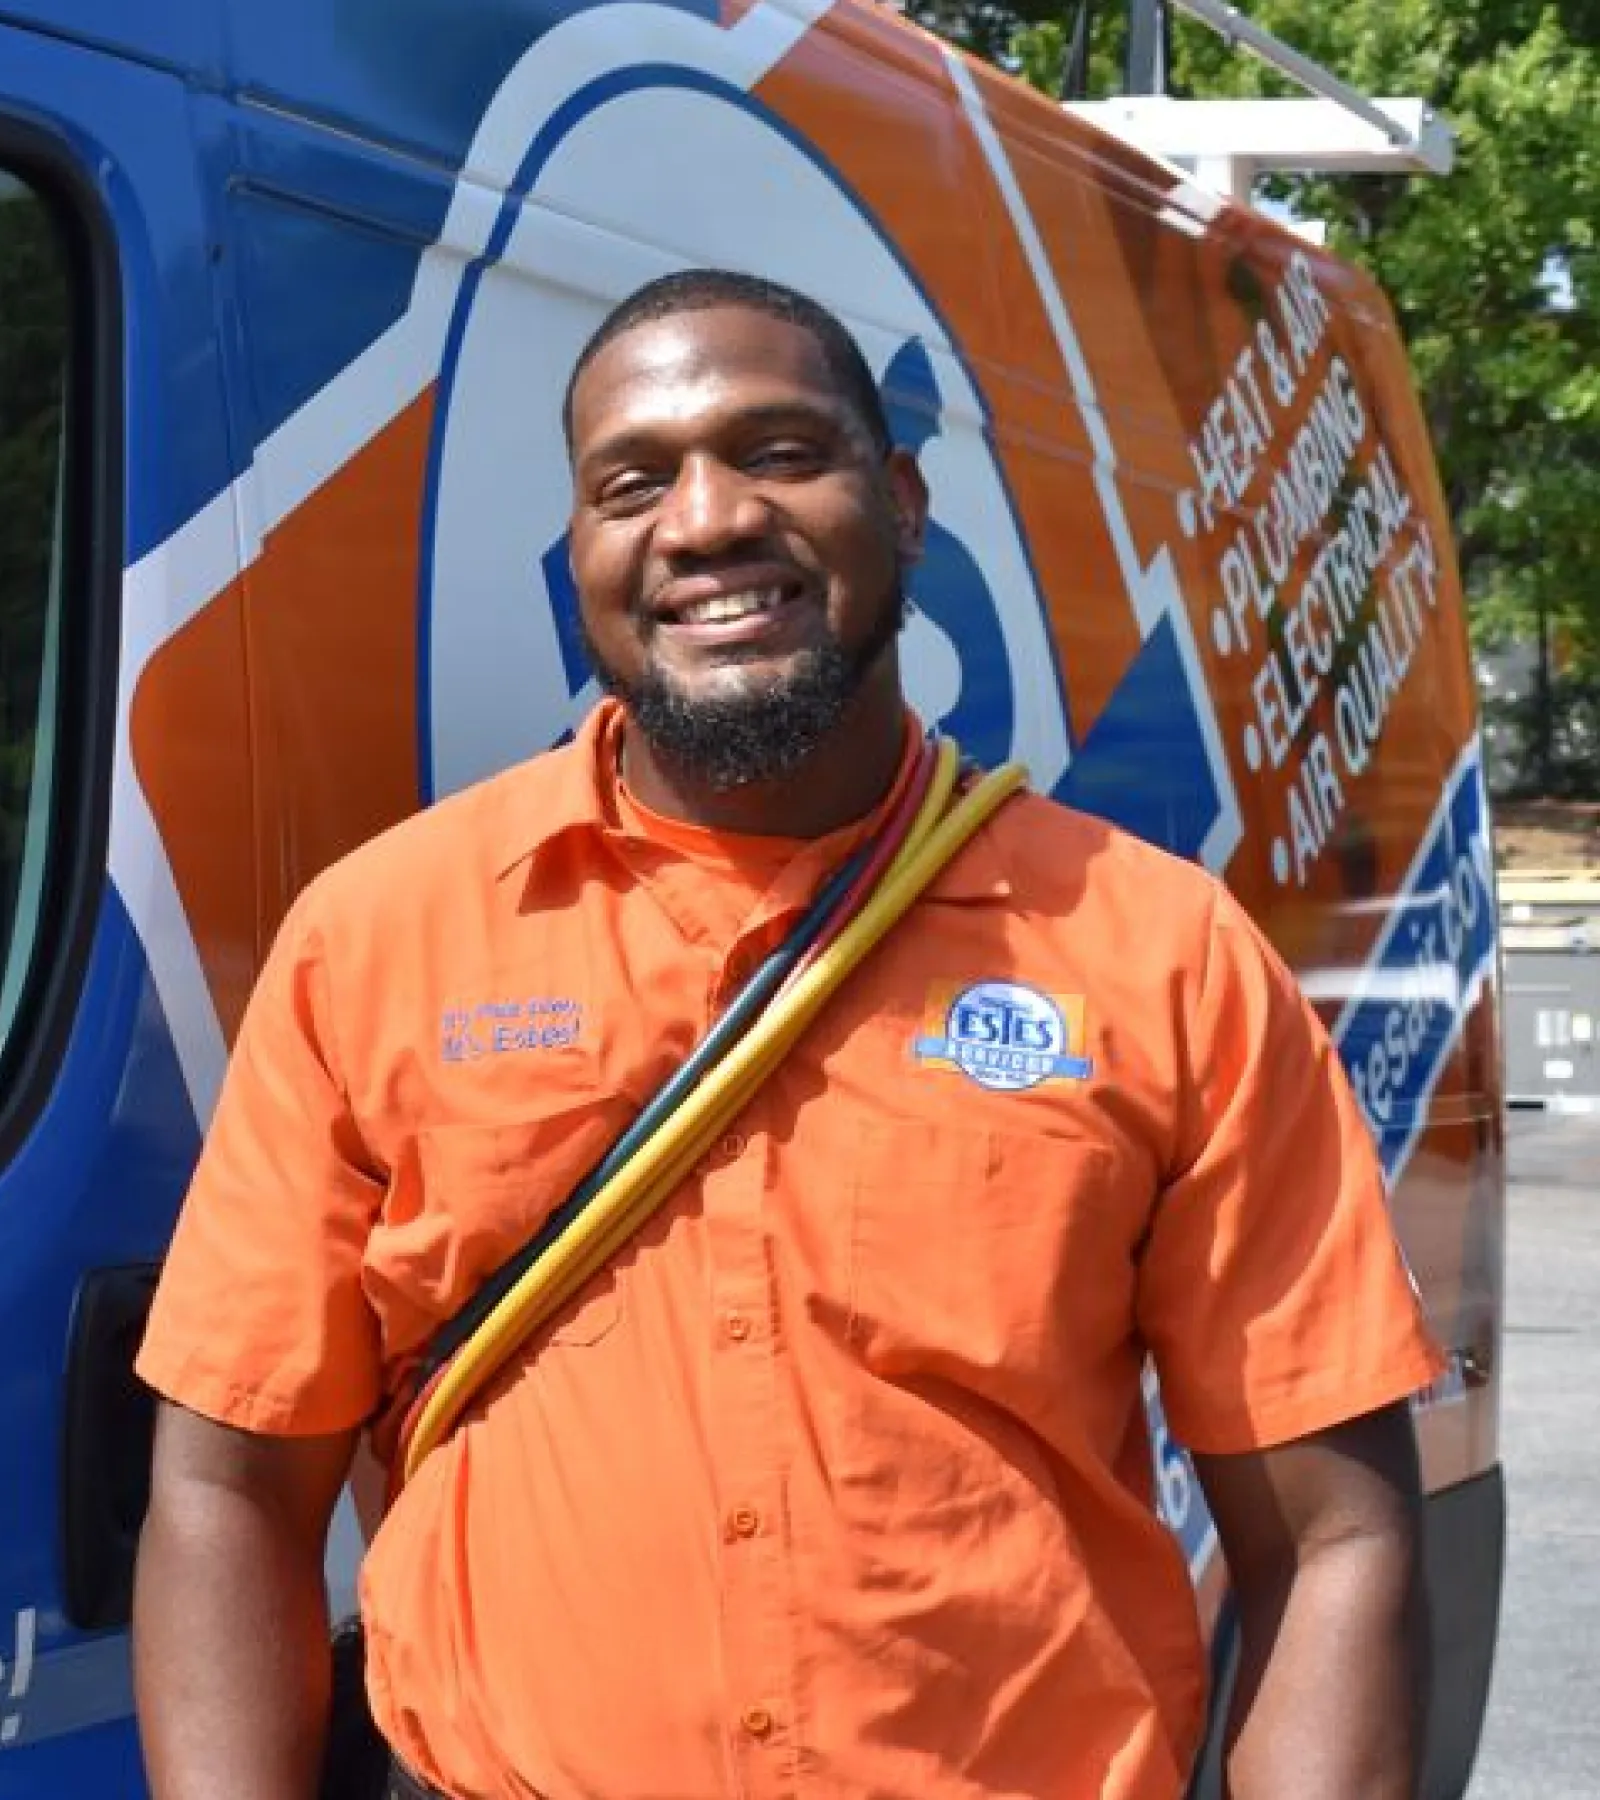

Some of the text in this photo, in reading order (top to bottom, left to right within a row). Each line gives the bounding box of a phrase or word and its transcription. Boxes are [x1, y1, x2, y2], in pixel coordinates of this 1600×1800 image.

[1188, 250, 1331, 532] HEAT & AIR
[1215, 355, 1366, 655] PLUMBING
[1252, 445, 1412, 770] ELECTRICAL
[1286, 520, 1437, 886] AIR QUALITY
[957, 996, 1054, 1049] ESTES
